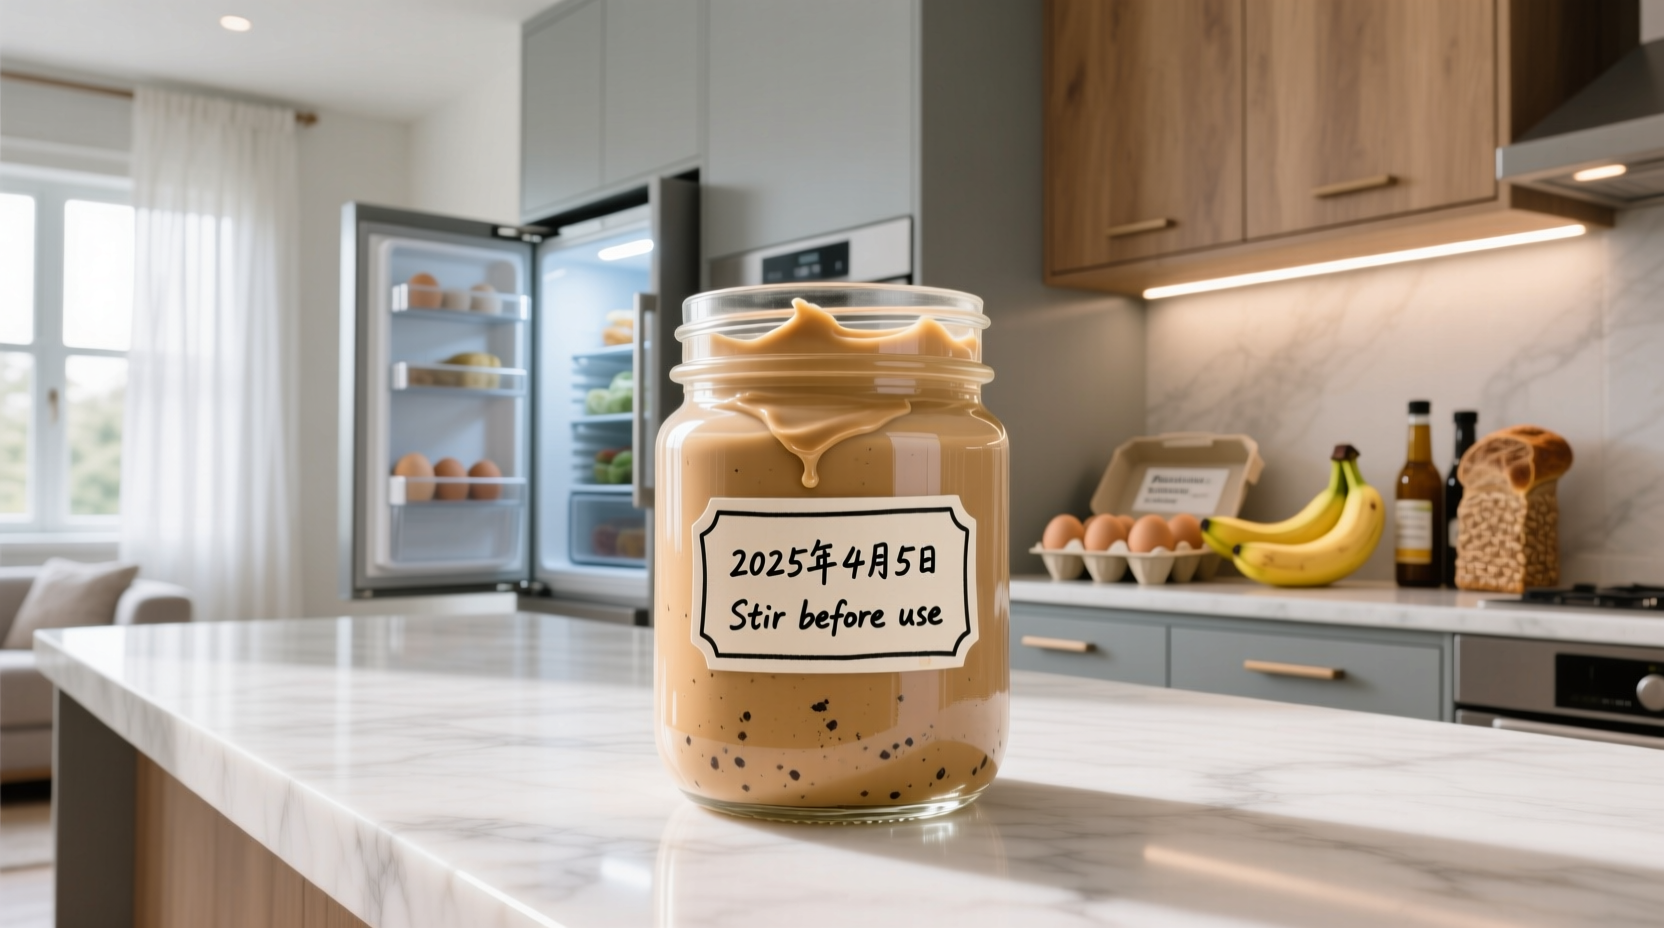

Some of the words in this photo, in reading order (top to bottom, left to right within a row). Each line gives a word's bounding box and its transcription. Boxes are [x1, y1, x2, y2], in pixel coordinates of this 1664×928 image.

[729, 538, 937, 586] 2025年4月5日
[729, 598, 787, 631] Stir
[798, 598, 886, 638] before
[898, 605, 944, 628] use
